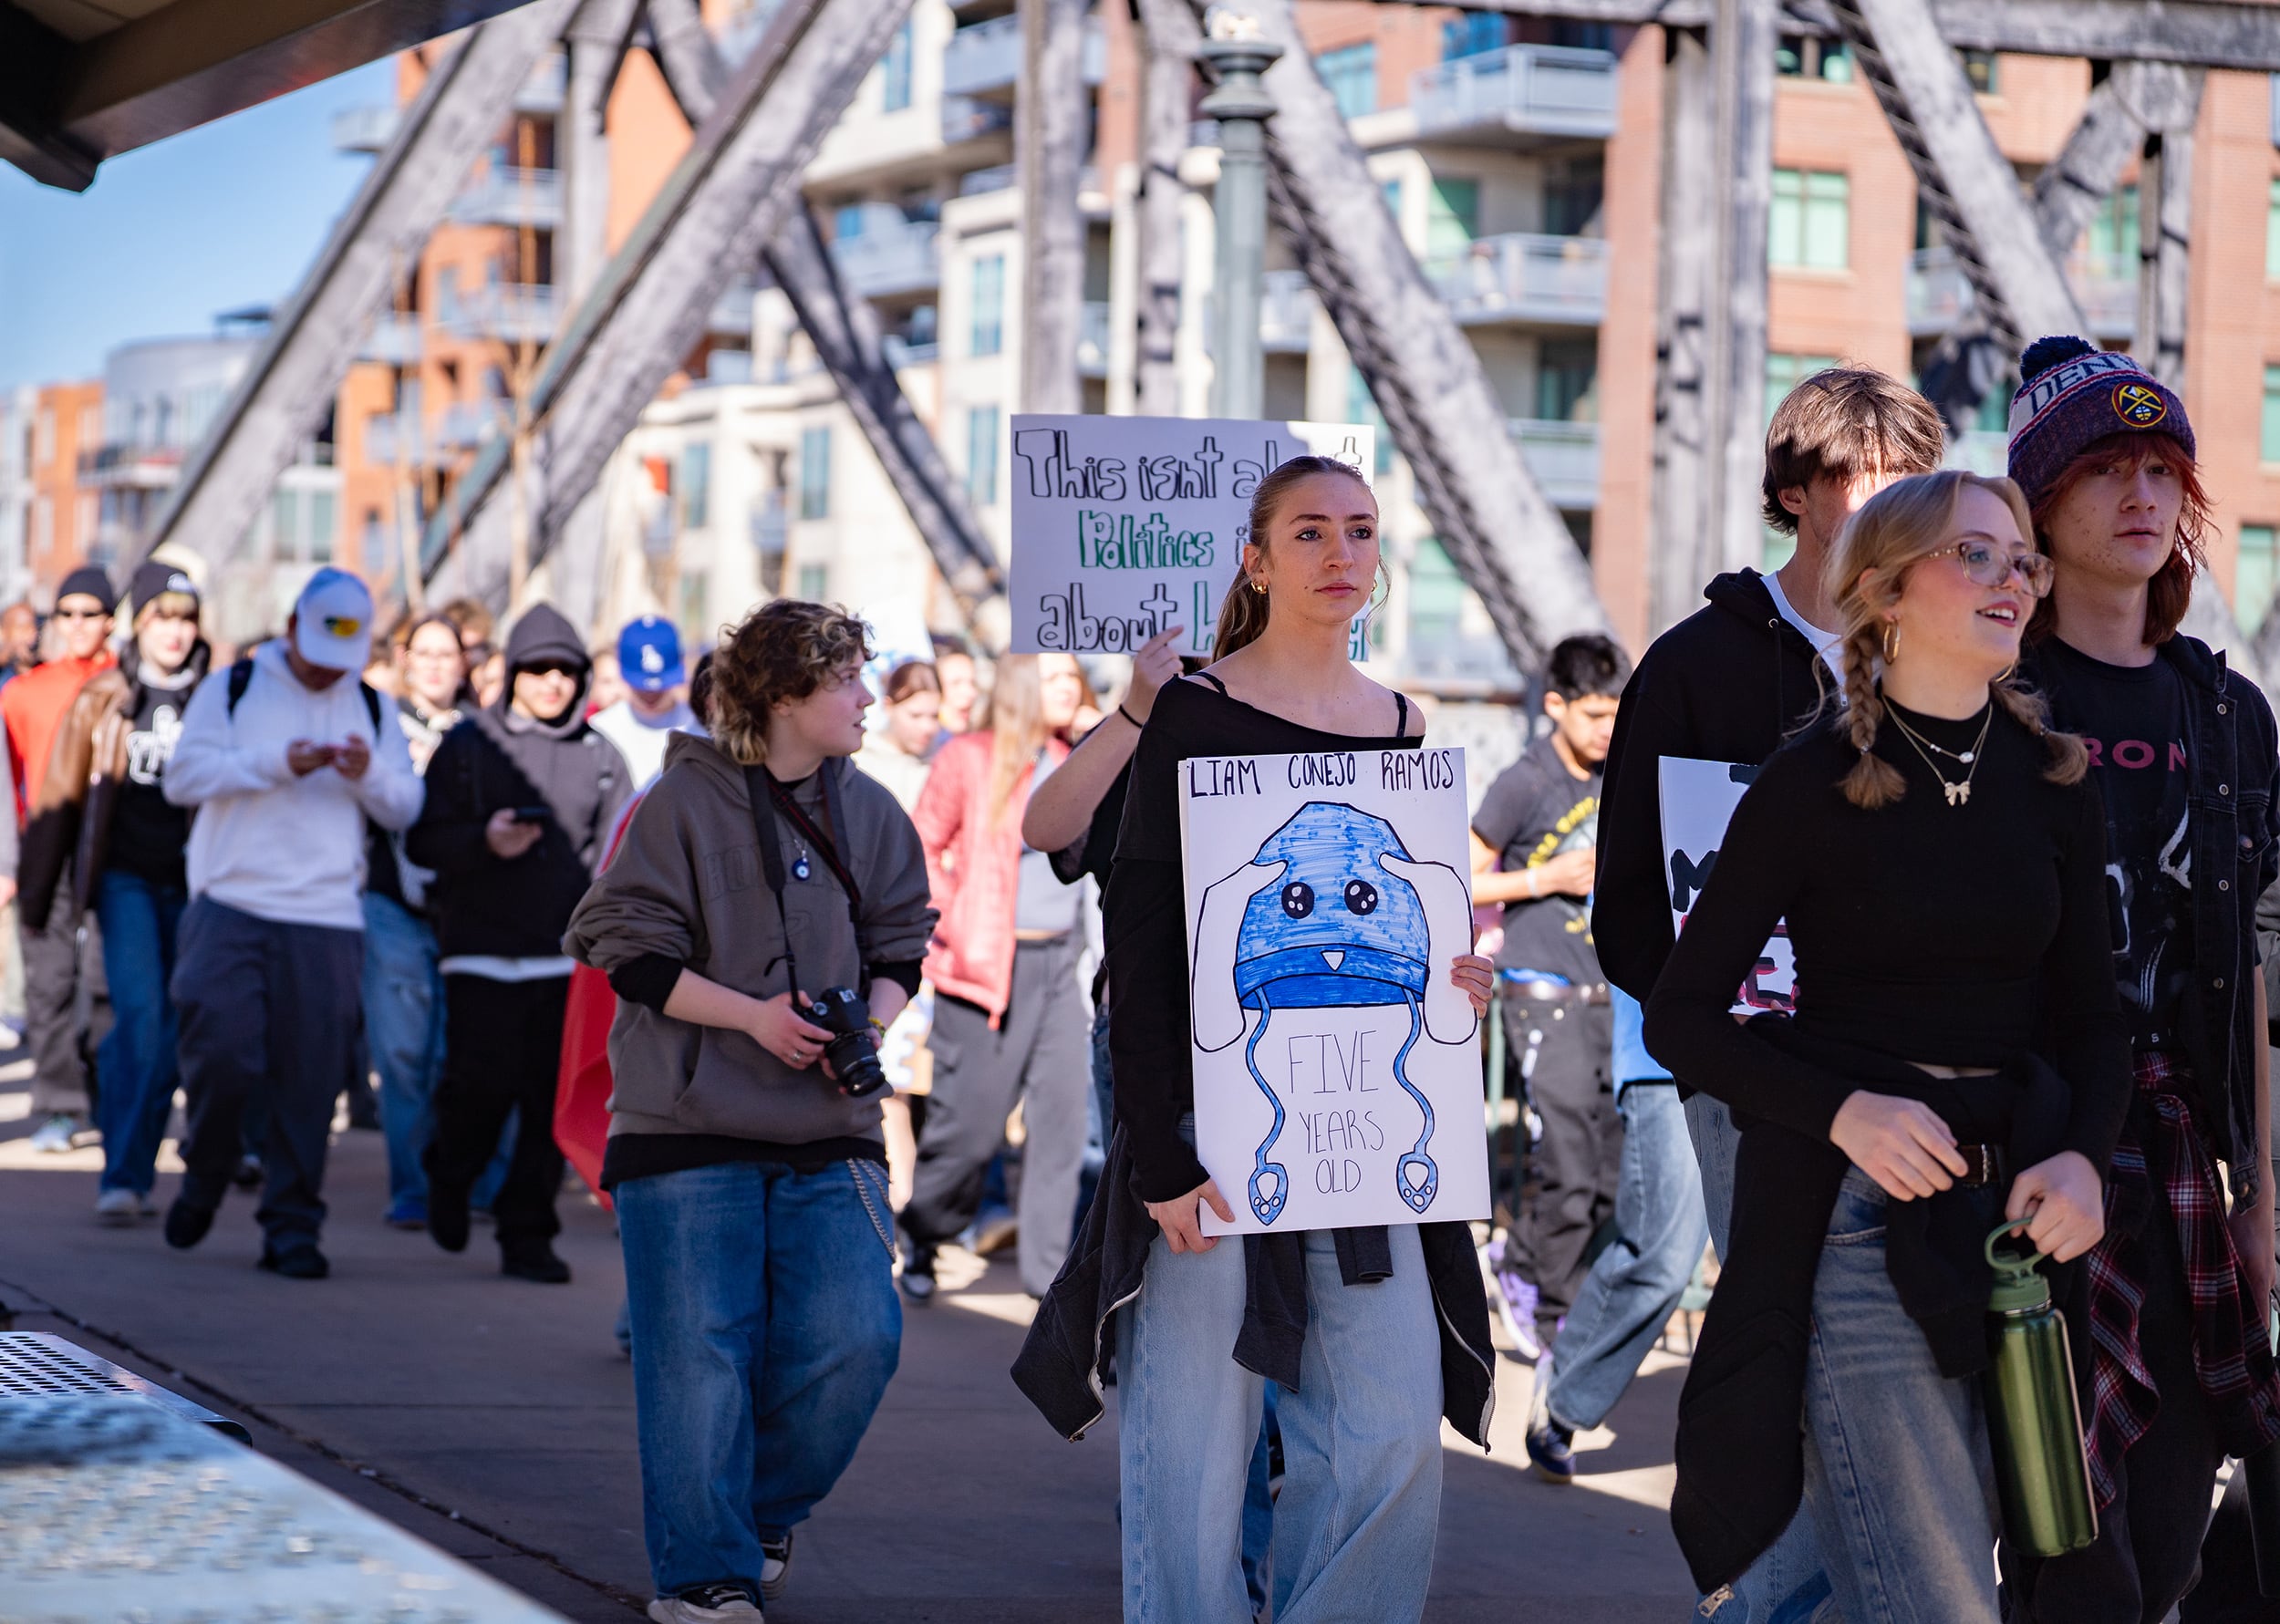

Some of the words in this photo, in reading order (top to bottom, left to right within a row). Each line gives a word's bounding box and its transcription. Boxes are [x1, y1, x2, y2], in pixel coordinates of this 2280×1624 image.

[1015, 429, 1126, 501] This
[1079, 510, 1214, 570] Politics
[1037, 582, 1177, 653] about
[1190, 760, 1261, 798] LIAM
[1288, 752, 1356, 789] CONEJO
[1381, 750, 1454, 791] RAMOS
[1288, 1030, 1379, 1094] FIVE
[1299, 1110, 1384, 1153] YEARS
[1314, 1159, 1361, 1195] OLD
